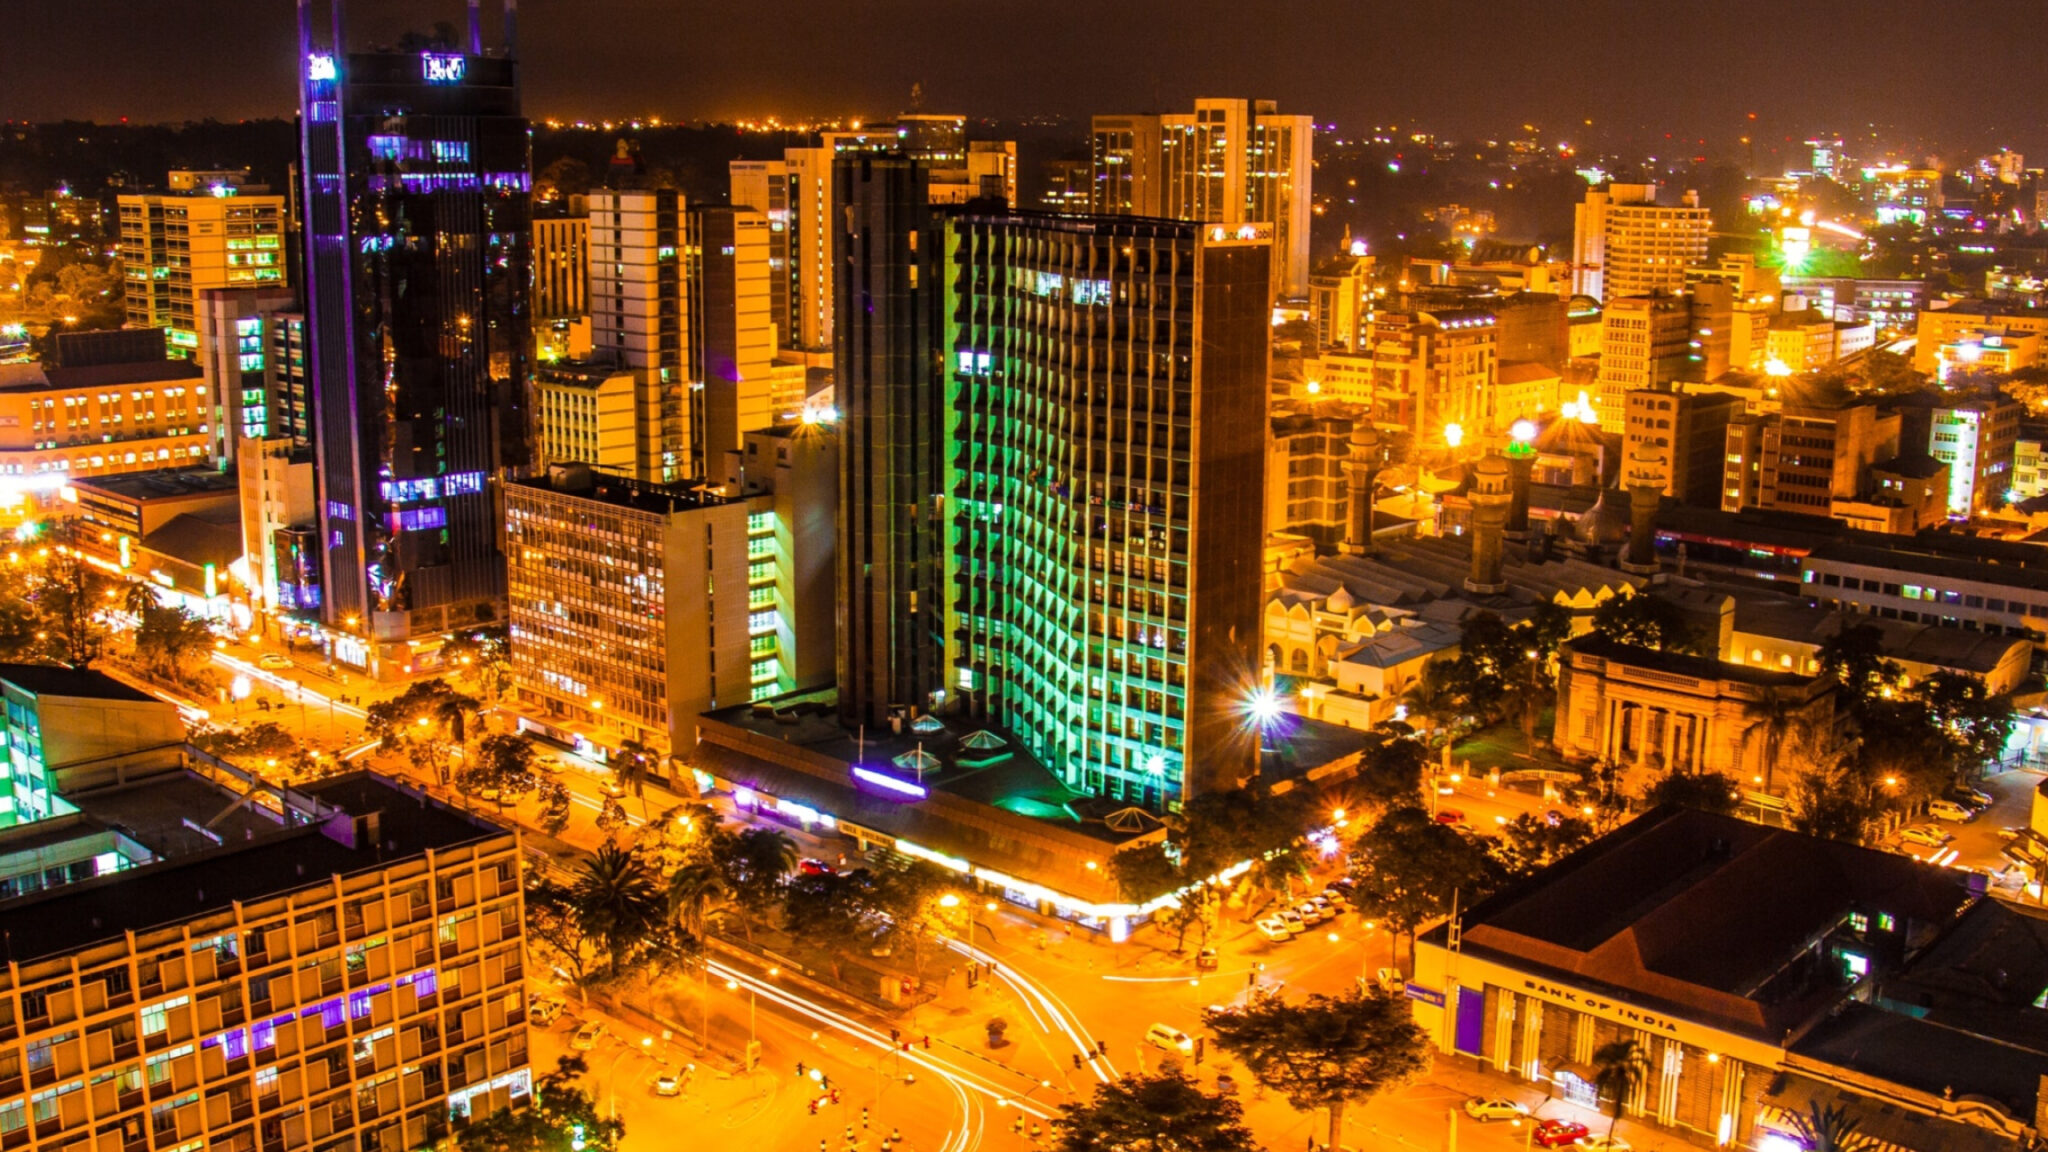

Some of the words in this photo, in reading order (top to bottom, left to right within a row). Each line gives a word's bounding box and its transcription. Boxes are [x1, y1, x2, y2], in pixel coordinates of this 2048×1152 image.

[1524, 980, 1577, 1002] BANK
[1585, 999, 1611, 1011] OF
[1618, 1008, 1678, 1032] INDIA
